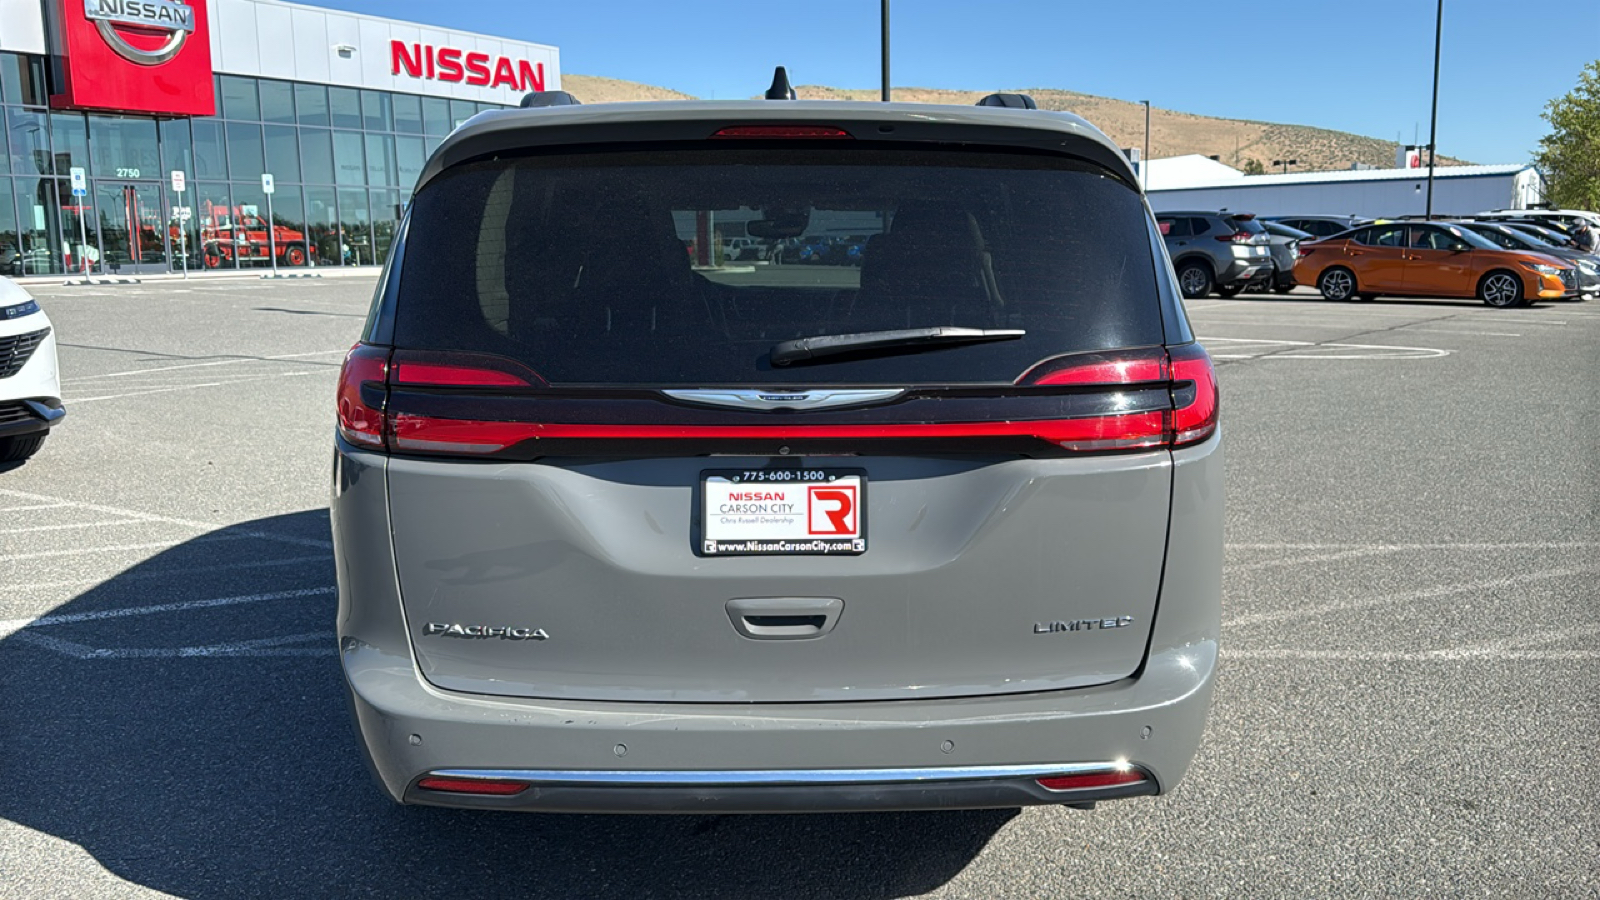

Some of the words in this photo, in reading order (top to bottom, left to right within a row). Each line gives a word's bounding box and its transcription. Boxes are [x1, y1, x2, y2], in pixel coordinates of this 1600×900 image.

[99, 0, 187, 24] NISSAN
[390, 40, 545, 92] NISSAN
[116, 168, 140, 178] 2750
[743, 471, 825, 480] 775-600-1500
[729, 491, 785, 501] NISSAN
[719, 503, 767, 513] CARSON
[770, 503, 794, 513] CITY
[718, 540, 852, 554] www.NissanCarsonCity.com
[426, 622, 550, 640] PACIFICA
[1033, 615, 1134, 634] LIMITED
